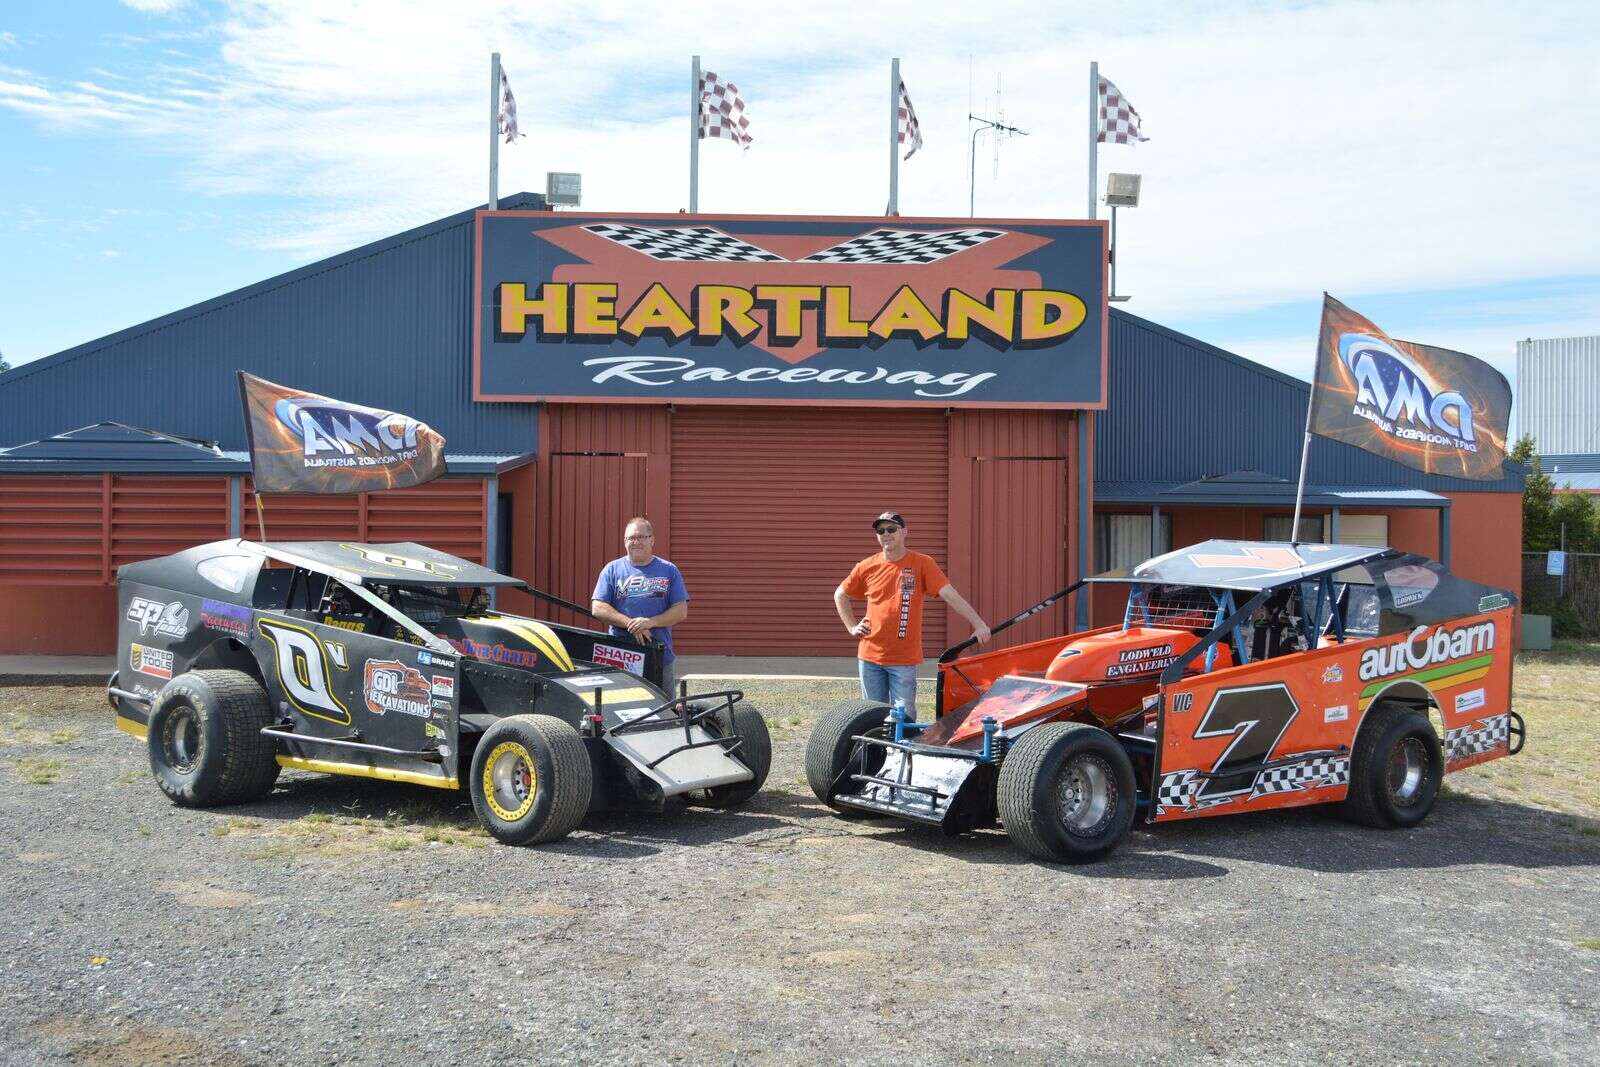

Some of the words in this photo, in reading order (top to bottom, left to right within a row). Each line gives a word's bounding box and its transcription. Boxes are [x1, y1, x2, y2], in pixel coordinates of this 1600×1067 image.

[496, 281, 1087, 350] HEARTLAND
[582, 355, 996, 397] Raceway
[143, 655, 173, 670] TOOLS
[144, 646, 173, 661] UNITED
[432, 656, 456, 668] BRAKE
[594, 645, 642, 663] SHARP
[1119, 645, 1172, 662] LODWELD
[372, 690, 431, 718] EXCAVATIONS
[1173, 692, 1192, 713] VIC
[1193, 682, 1299, 801] 7
